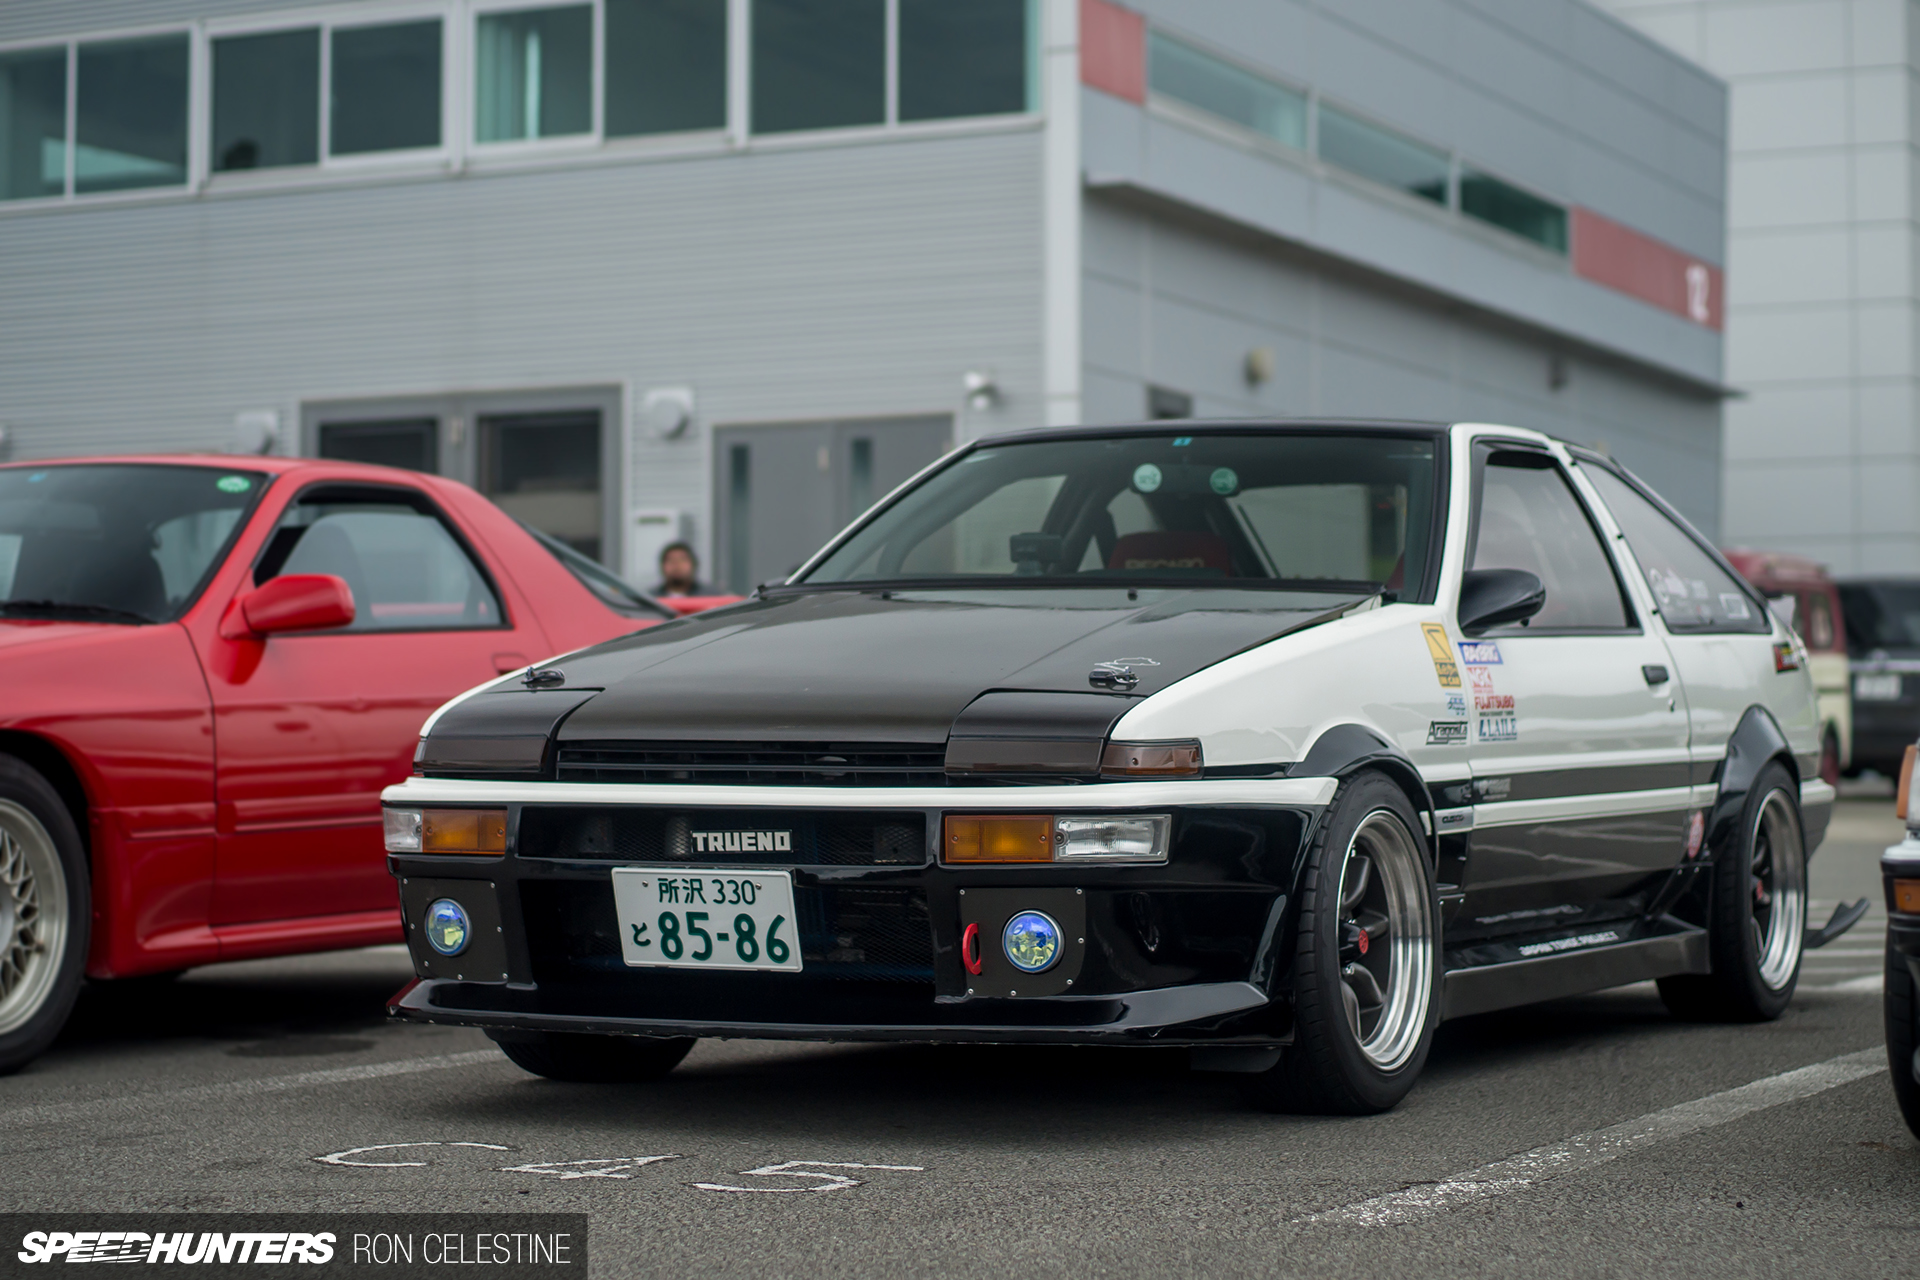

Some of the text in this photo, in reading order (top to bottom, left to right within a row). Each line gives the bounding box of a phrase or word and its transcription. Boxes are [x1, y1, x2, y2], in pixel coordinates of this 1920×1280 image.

[1466, 666, 1493, 687] NGK
[1474, 695, 1515, 710] FUJITSUBO
[692, 831, 792, 852] TRUENO
[657, 877, 757, 905] 所沢 330
[631, 911, 791, 964] と 85-86
